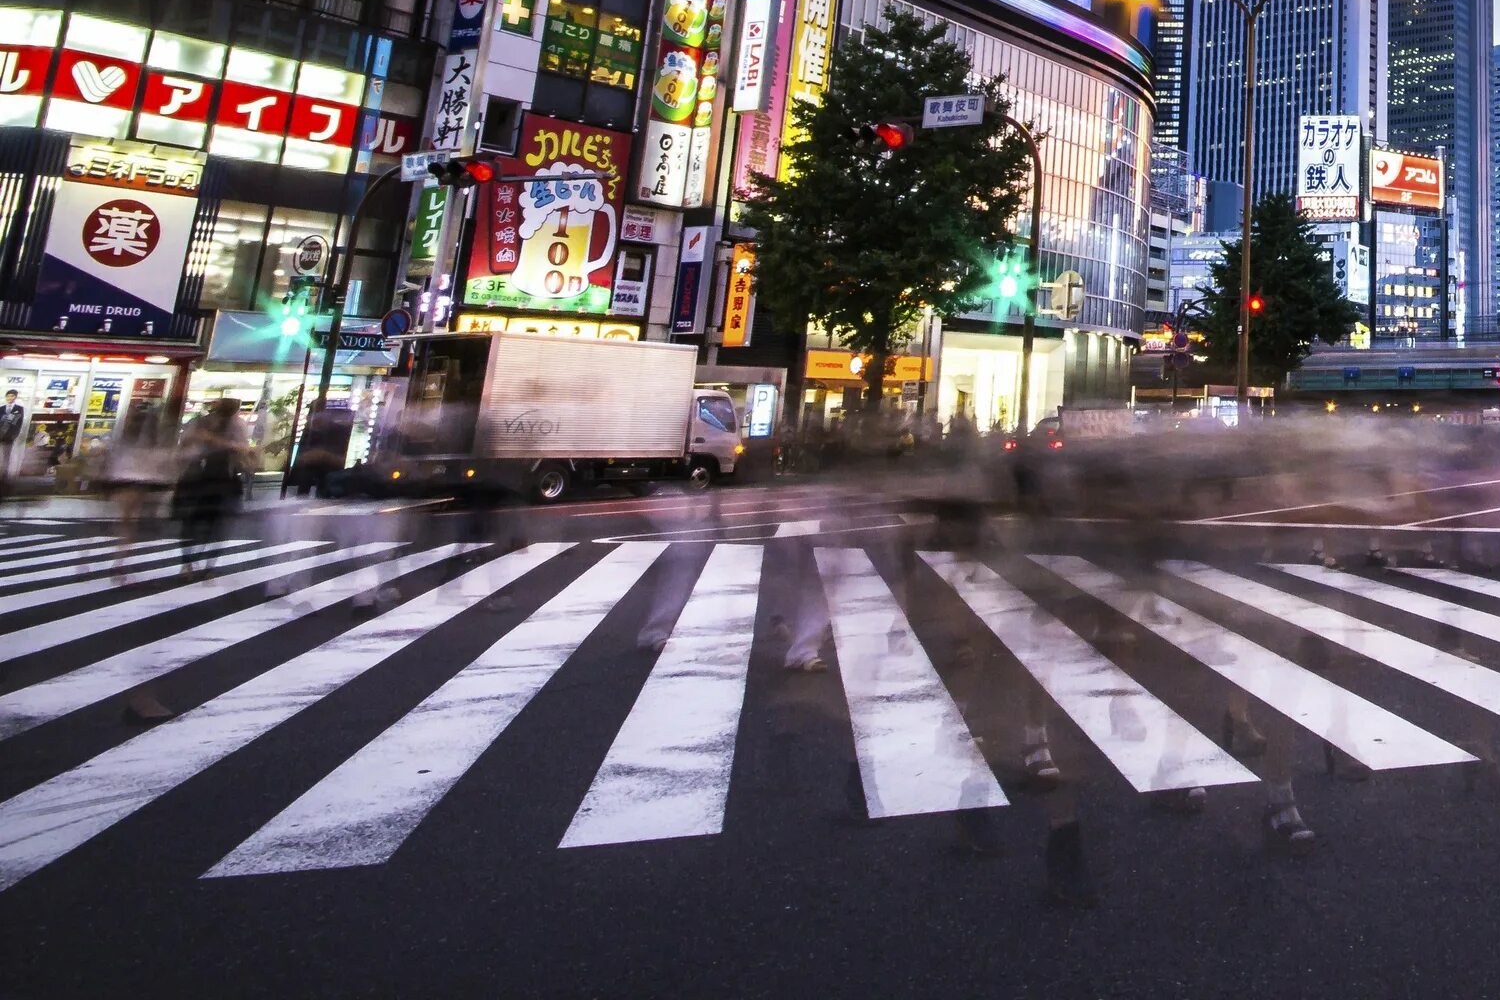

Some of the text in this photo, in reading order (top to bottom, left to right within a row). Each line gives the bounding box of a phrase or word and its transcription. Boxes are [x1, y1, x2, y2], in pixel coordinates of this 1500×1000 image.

[746, 43, 762, 88] LABI
[433, 55, 473, 147] 大勝軒
[930, 98, 979, 114] 歌舞伎町
[159, 75, 405, 156] アイフル
[1302, 118, 1359, 148] カラオケ
[525, 128, 622, 201] カルビちゃん
[652, 133, 674, 196] 日高屋
[1323, 149, 1335, 166] の
[1305, 165, 1353, 192] 鉄人
[1404, 165, 1437, 185] アコム
[529, 178, 597, 208] 生ビール
[1400, 191, 1413, 201] 2F
[89, 206, 155, 259] 薬
[421, 191, 445, 249] レイク
[625, 223, 653, 241] 修理
[68, 303, 142, 317] MINE DRUG
[320, 333, 385, 349] PNDORA
[142, 379, 157, 391] 2F
[756, 389, 769, 408] P
